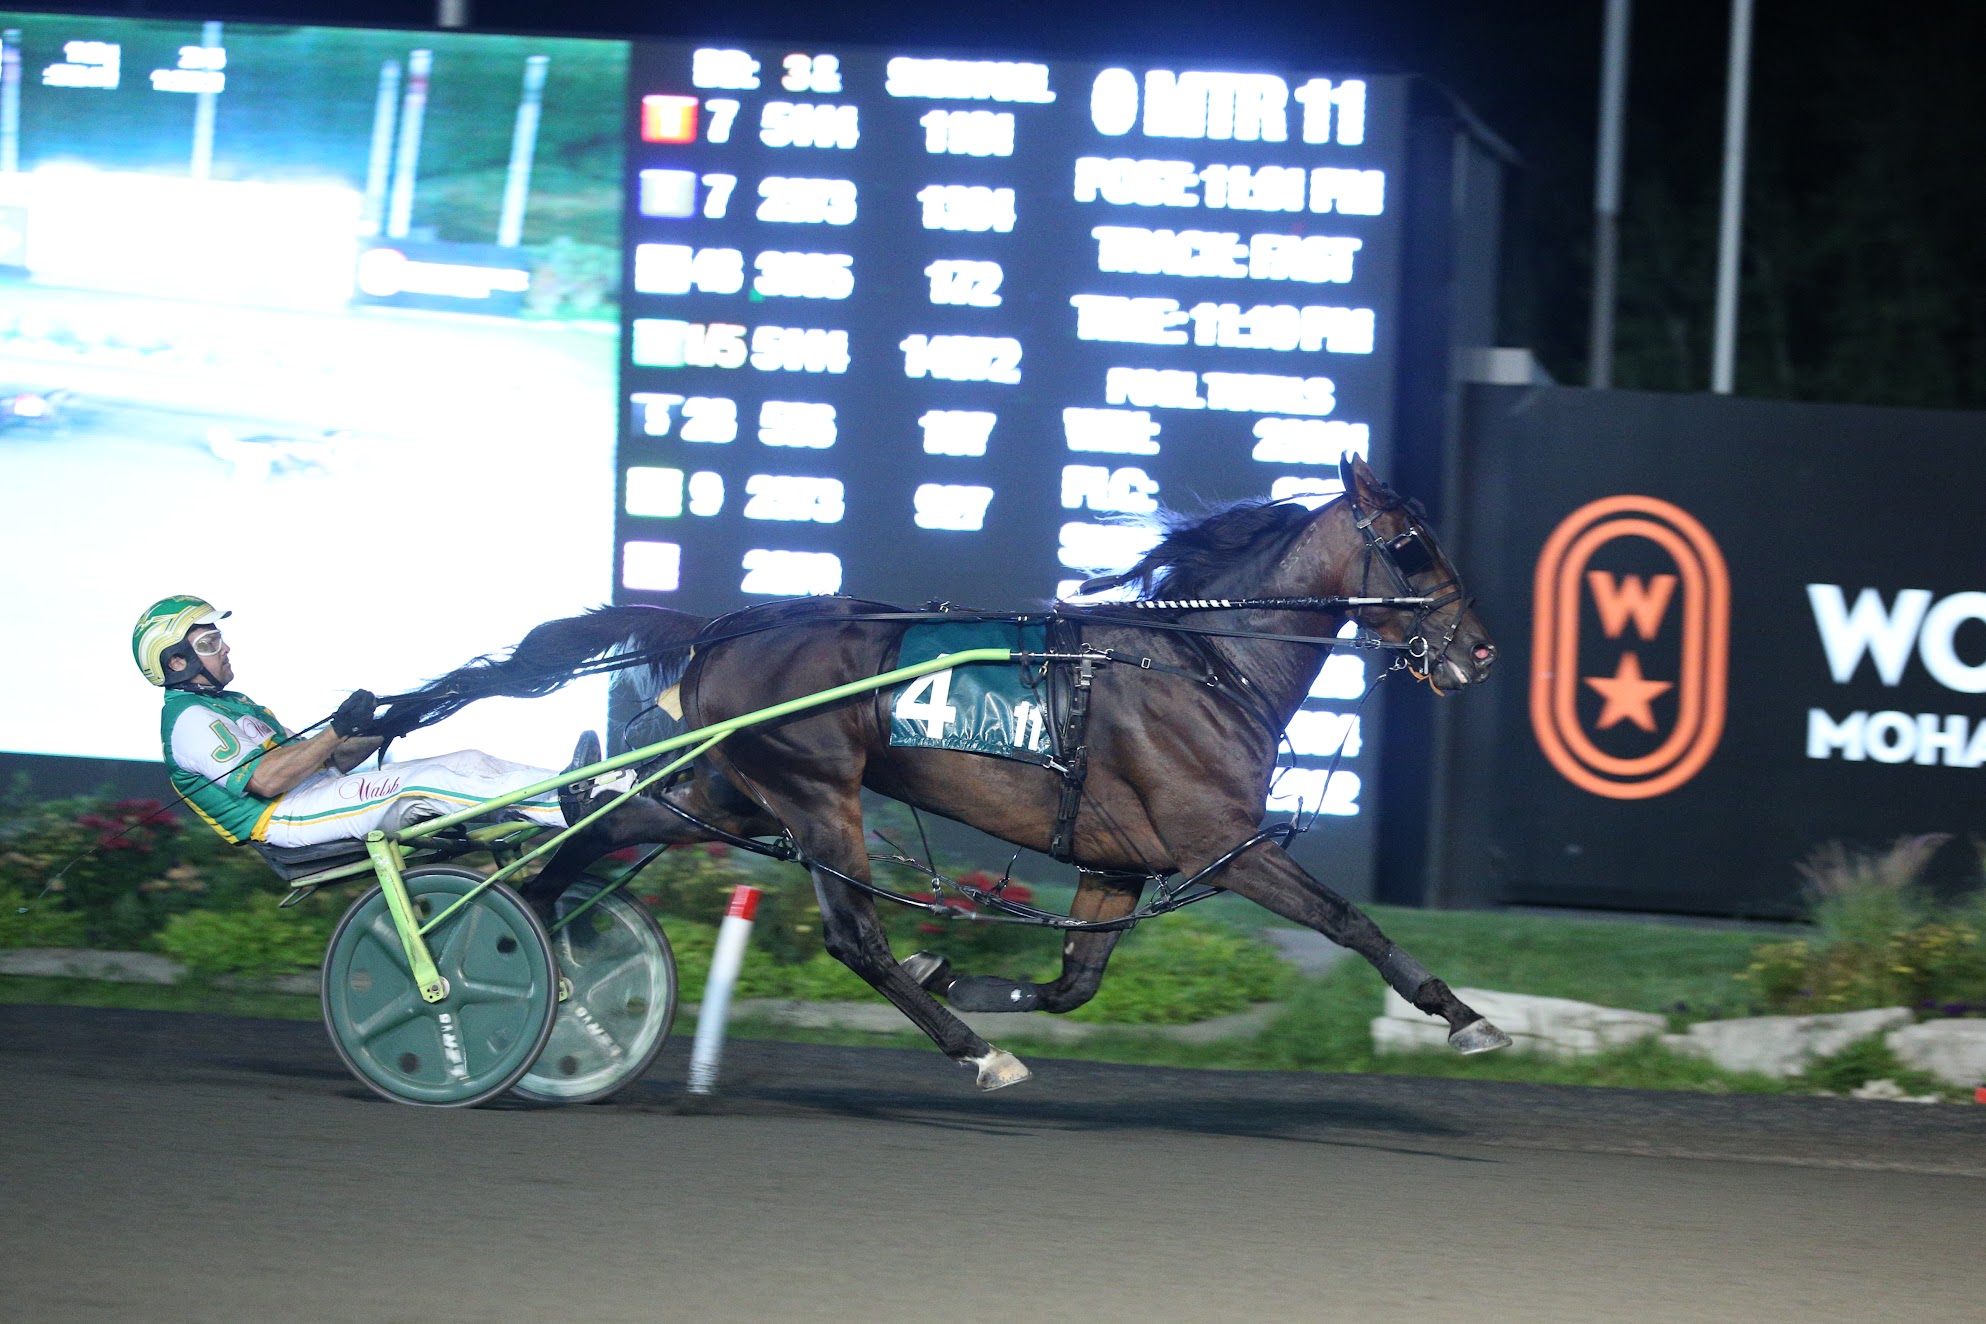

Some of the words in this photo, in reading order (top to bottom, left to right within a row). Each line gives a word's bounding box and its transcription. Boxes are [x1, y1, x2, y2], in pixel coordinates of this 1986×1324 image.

[705, 99, 740, 143] 7
[701, 173, 737, 218] 7
[1587, 571, 1677, 641] W
[1807, 584, 1986, 694] WO
[896, 653, 956, 739] 4
[209, 720, 241, 763] J
[338, 776, 400, 801] Walsh
